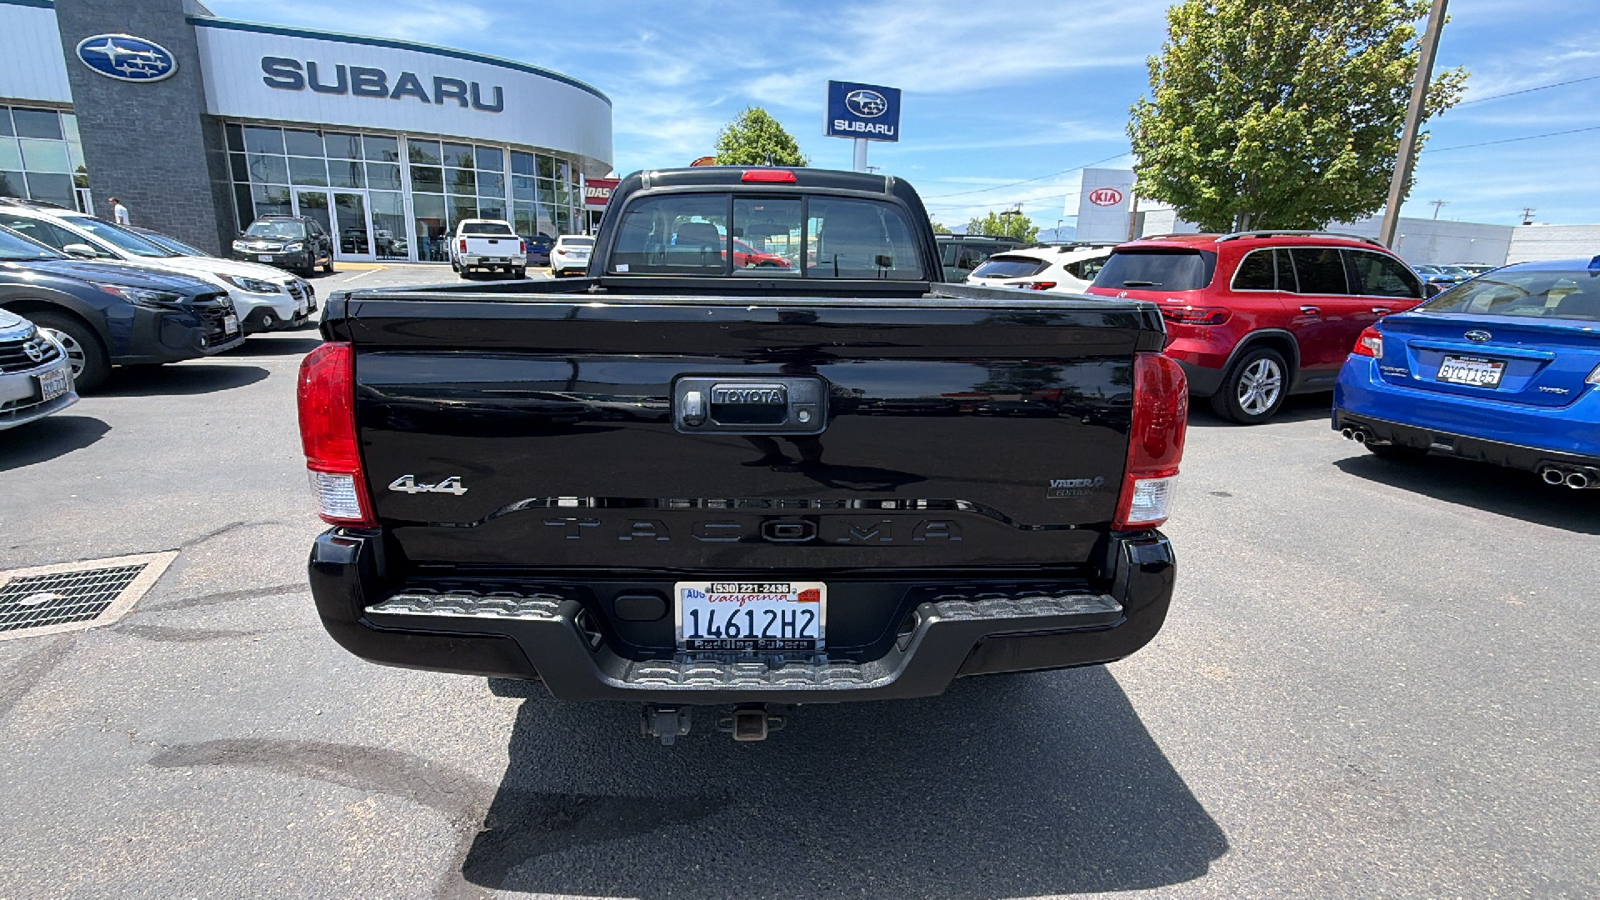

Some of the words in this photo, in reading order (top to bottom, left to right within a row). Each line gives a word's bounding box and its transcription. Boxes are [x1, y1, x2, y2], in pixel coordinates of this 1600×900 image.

[261, 56, 504, 113] SUBARU
[834, 119, 894, 135] SUBARU
[585, 187, 611, 198] IDAS
[717, 389, 783, 403] TOYOTA
[1049, 479, 1094, 488] VADER
[1056, 488, 1094, 497] EDITION
[542, 518, 962, 541] TACOMA
[686, 589, 706, 599] AUG
[713, 583, 739, 593] (530)
[741, 583, 789, 593] 221-2436
[688, 608, 815, 639] 14612H2
